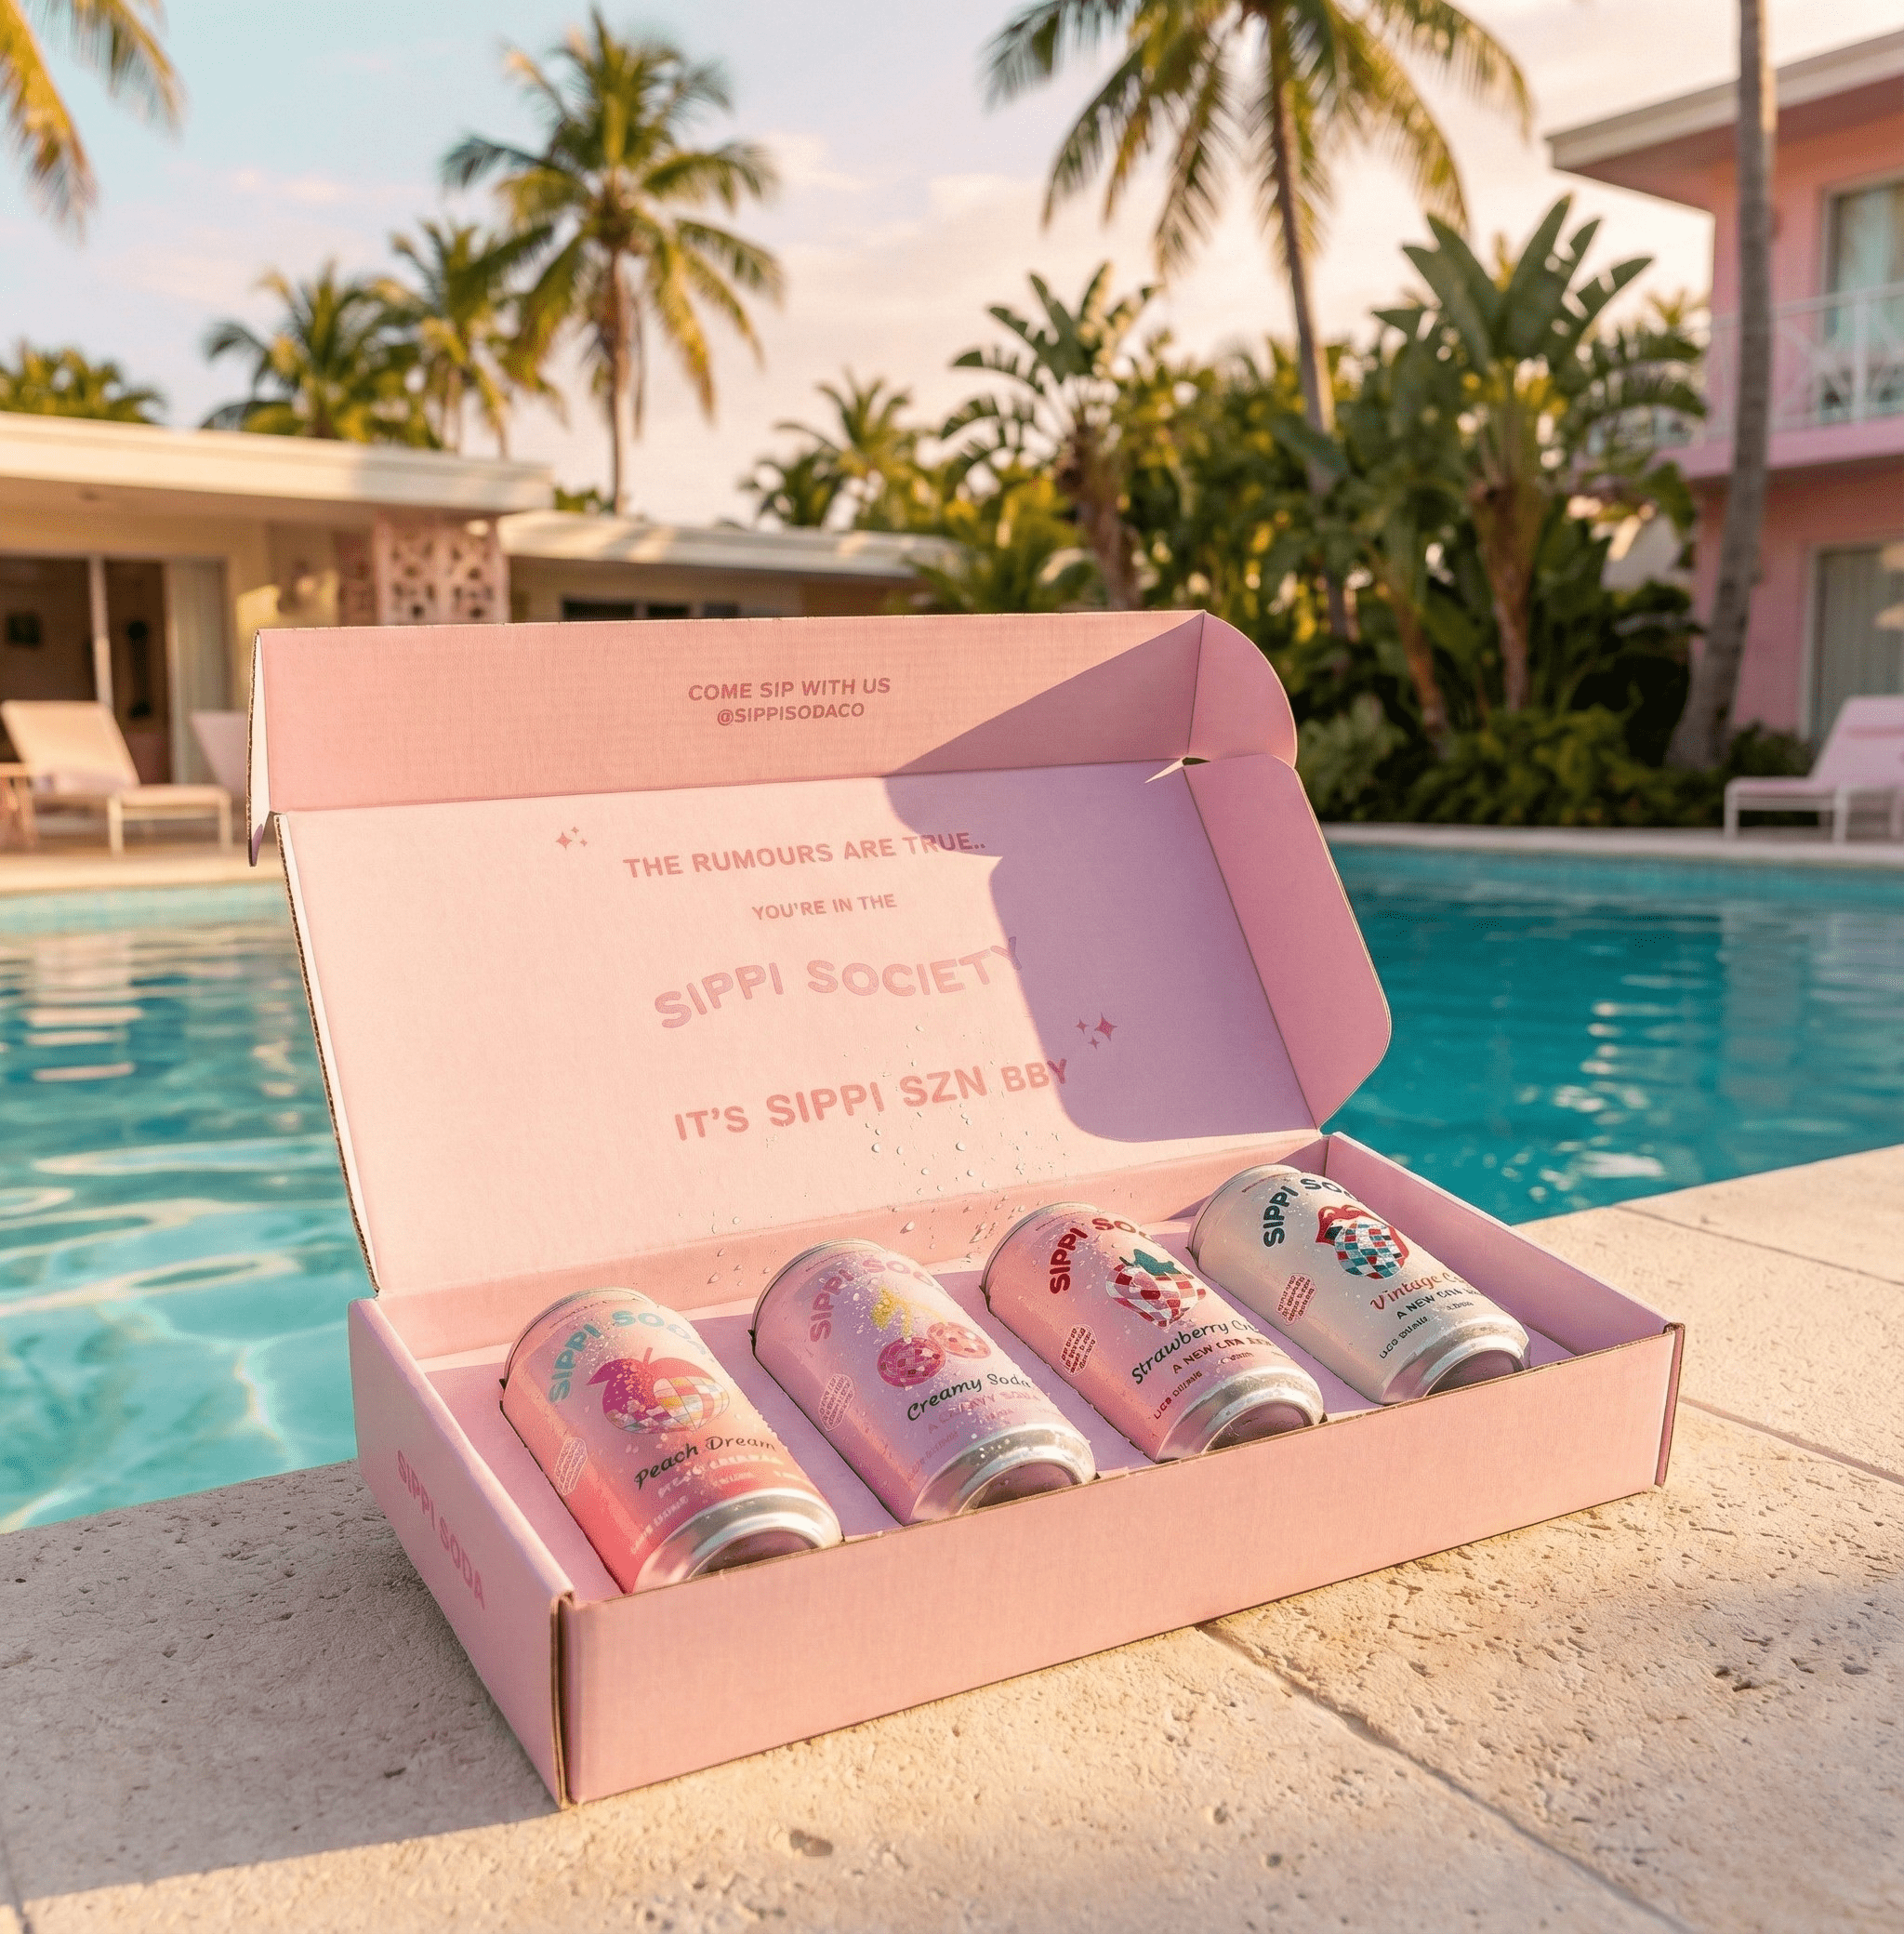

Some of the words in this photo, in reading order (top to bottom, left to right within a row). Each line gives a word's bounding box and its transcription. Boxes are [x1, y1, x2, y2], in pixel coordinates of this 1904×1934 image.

[689, 682, 752, 701] COME
[760, 681, 794, 699] SIP
[801, 679, 855, 697] WITH
[863, 678, 892, 694] US
[717, 703, 865, 726] @SIPPISODACO
[623, 855, 683, 878] THE
[693, 844, 833, 872] RUMOURS
[843, 839, 896, 860] ARE
[903, 832, 985, 853] TRUE..
[752, 900, 826, 921] YOU'RE
[833, 898, 853, 912] IN
[857, 894, 897, 910] THE
[654, 962, 785, 1028] SIPPI
[807, 936, 1022, 996] SOCIETY
[675, 1106, 749, 1141] IT’S
[766, 1082, 884, 1128] SIPPI
[900, 1066, 987, 1108] SZN
[1000, 1058, 1067, 1092] BBY
[1263, 1186, 1300, 1247] SIPPI
[1050, 1227, 1088, 1293] SIPPI
[810, 1269, 853, 1342] SIPPI
[1370, 1275, 1442, 1311] Vintage
[1396, 1311, 1407, 1319] A
[1407, 1295, 1435, 1312] NEW
[549, 1323, 602, 1403] SIPPI
[1131, 1320, 1229, 1384] Strawberry
[1172, 1364, 1183, 1373] A
[1183, 1344, 1213, 1365] NEW
[907, 1379, 982, 1421] Creamy
[634, 1443, 698, 1490] Peach
[706, 1437, 776, 1450] Dream
[397, 1450, 435, 1530] SIPPI
[440, 1517, 485, 1610] SODA
